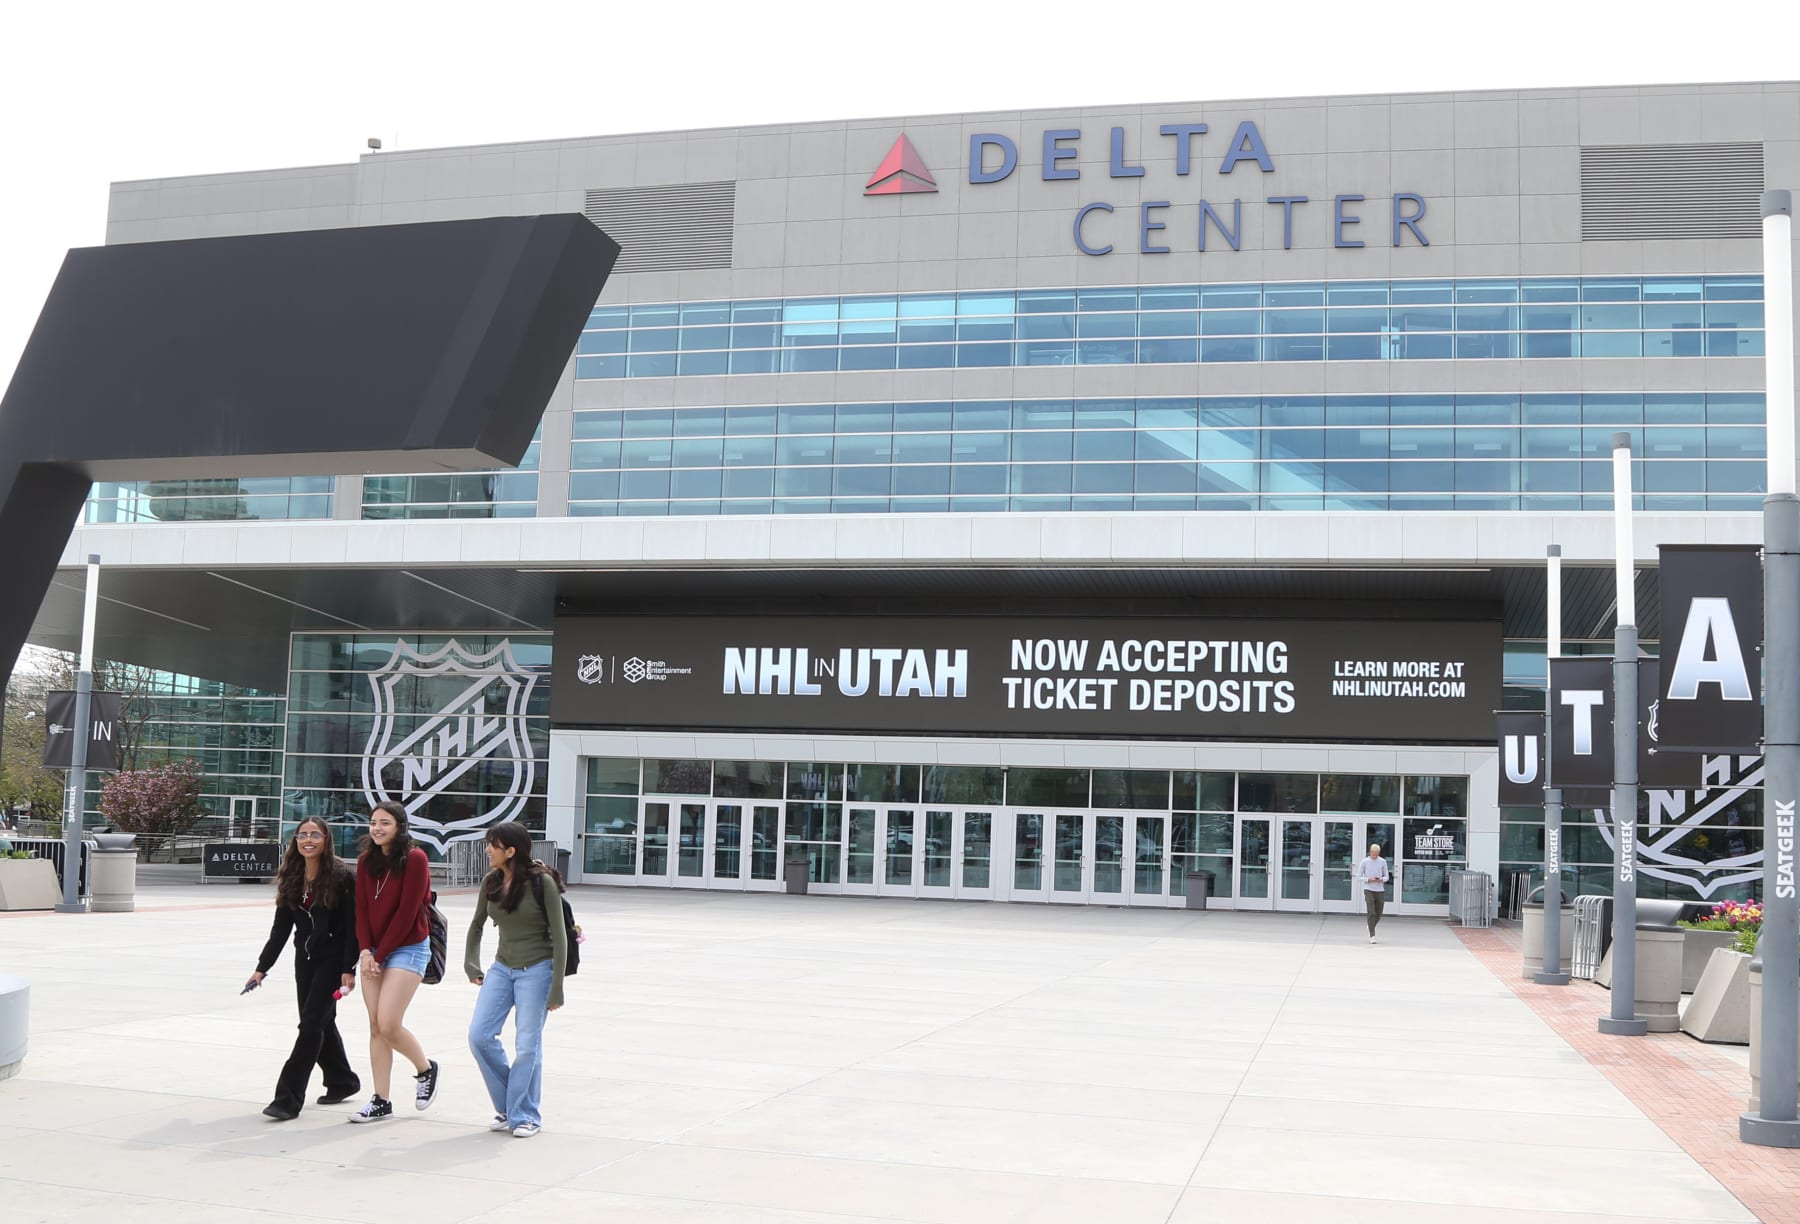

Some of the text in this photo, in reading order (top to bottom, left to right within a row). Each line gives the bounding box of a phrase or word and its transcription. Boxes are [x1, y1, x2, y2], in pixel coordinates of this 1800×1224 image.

[968, 120, 1275, 184] DELTA
[1072, 192, 1430, 256] CENTER
[723, 647, 969, 698] NHL IN UTAH
[1011, 639, 1289, 674] NOW ACCEPTING
[1334, 660, 1465, 678] LEARN MORE AT
[1666, 597, 1753, 701] A
[1002, 677, 1296, 713] TICKET DEPOSITS
[1332, 680, 1466, 698] NHLINUTAH.COM
[93, 720, 112, 741] IN
[1561, 690, 1604, 755] T
[401, 695, 499, 801] NHL
[1504, 735, 1538, 784] U
[223, 853, 256, 861] DELTA
[1415, 837, 1454, 848] TEAM STORE
[1548, 828, 1559, 874] SEATGEEK
[1620, 820, 1634, 882] SEATGEEK
[1775, 800, 1796, 899] SEATGEEK
[234, 863, 272, 871] CENTER
